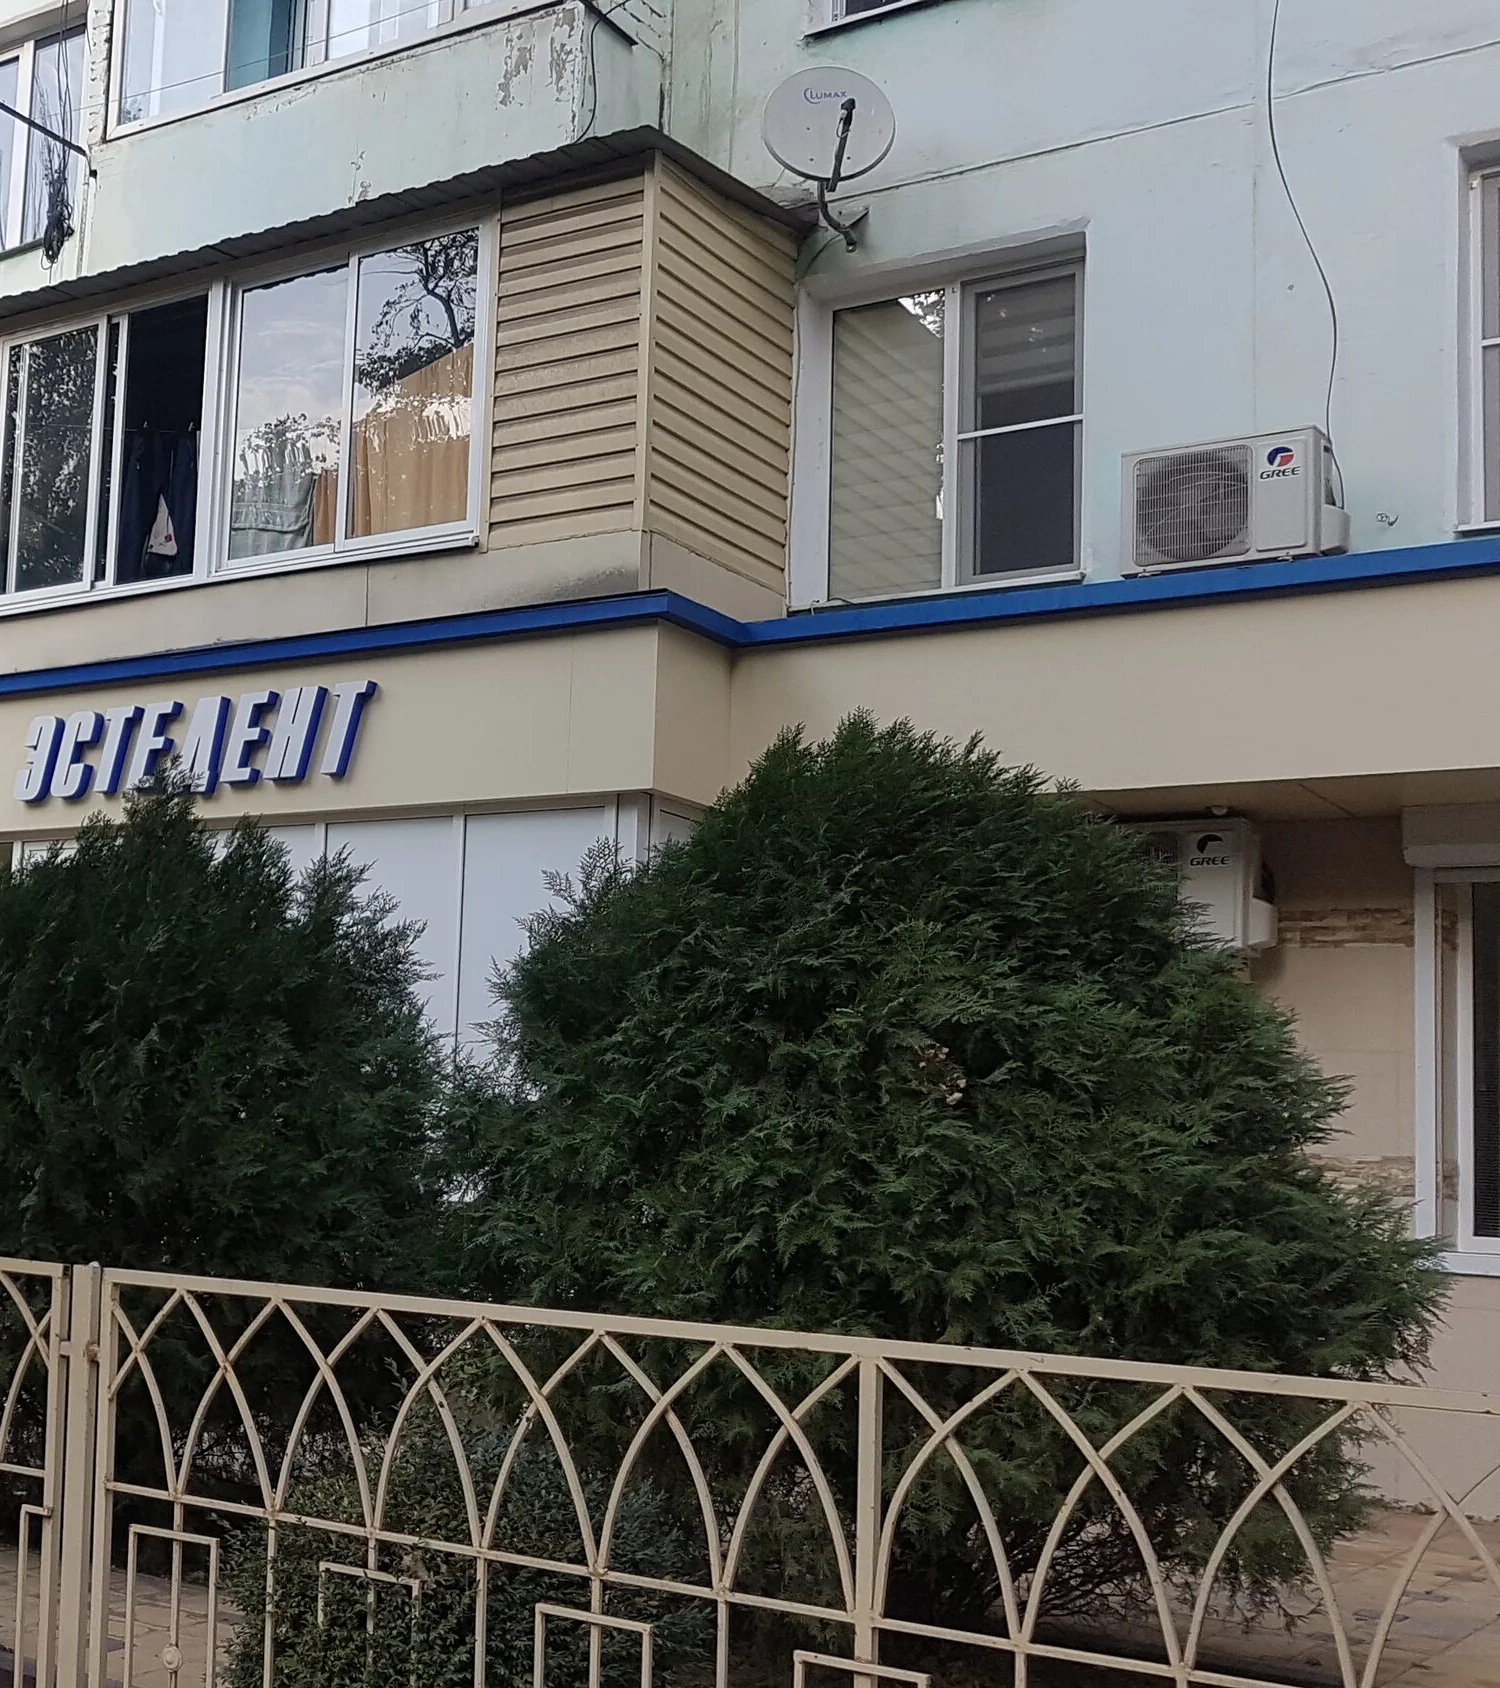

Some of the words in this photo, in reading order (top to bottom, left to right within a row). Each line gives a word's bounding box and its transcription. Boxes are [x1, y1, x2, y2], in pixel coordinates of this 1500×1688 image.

[807, 90, 847, 100] LUMAX
[1260, 466, 1301, 480] GREE
[1190, 856, 1230, 866] GREE
